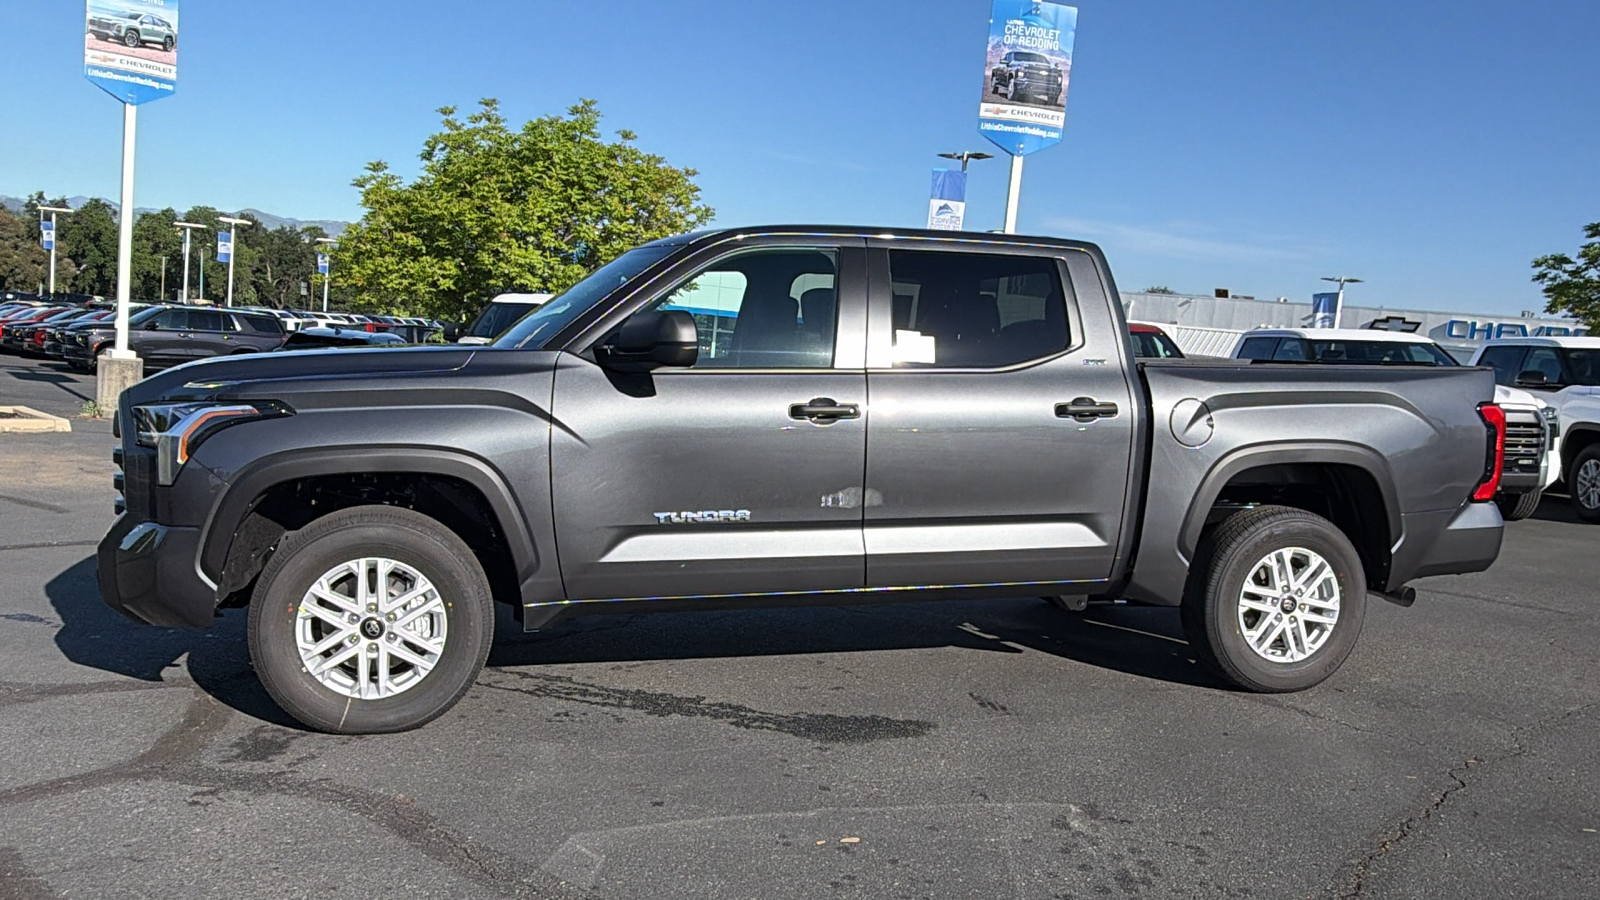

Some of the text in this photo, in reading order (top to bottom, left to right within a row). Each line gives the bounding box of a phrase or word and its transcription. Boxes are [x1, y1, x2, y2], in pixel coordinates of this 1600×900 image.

[1004, 25, 1060, 40] CHEVROLET
[1004, 35, 1059, 50] OF REDDING
[119, 58, 173, 74] CHEVROLET
[1010, 109, 1061, 121] CHEVROLET
[653, 509, 751, 524] TUNDRA
